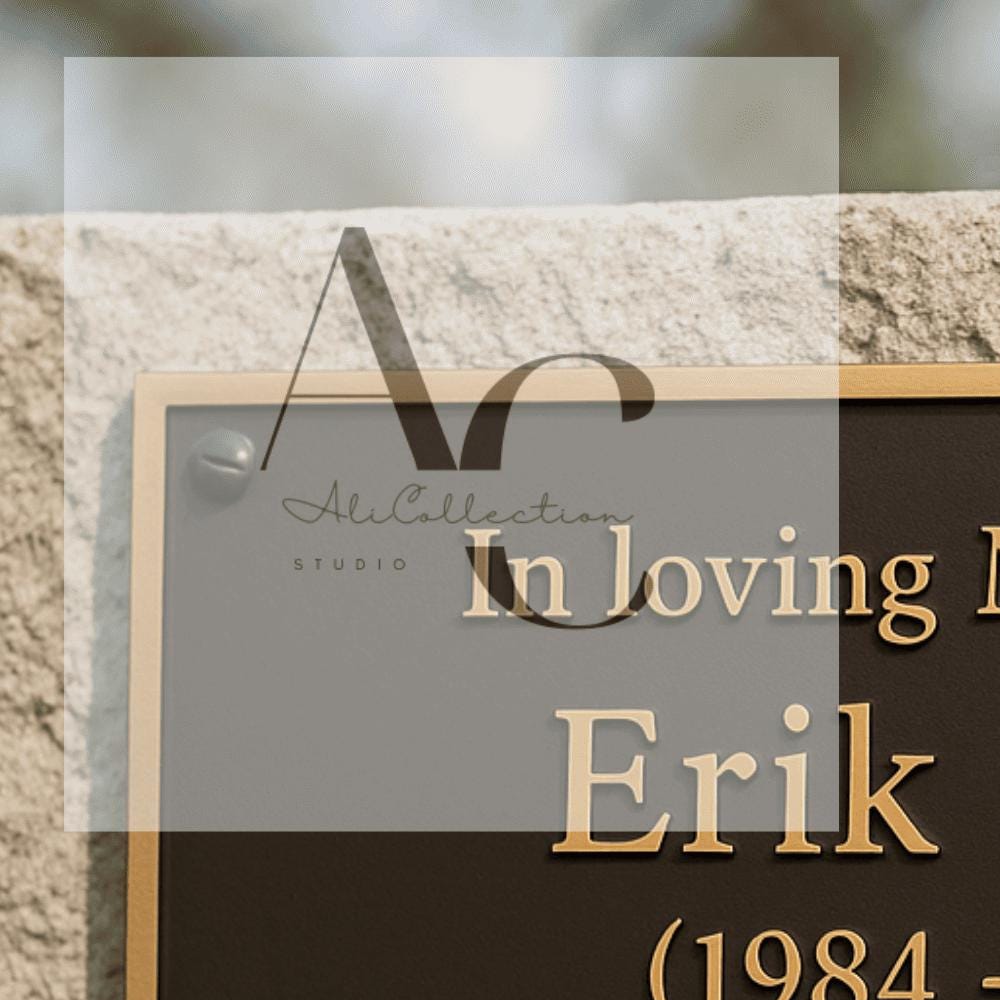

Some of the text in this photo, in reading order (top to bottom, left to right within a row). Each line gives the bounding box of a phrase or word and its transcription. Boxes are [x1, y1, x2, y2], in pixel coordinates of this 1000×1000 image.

[462, 527, 573, 619] In
[606, 524, 938, 645] loving
[551, 702, 941, 855] Erik
